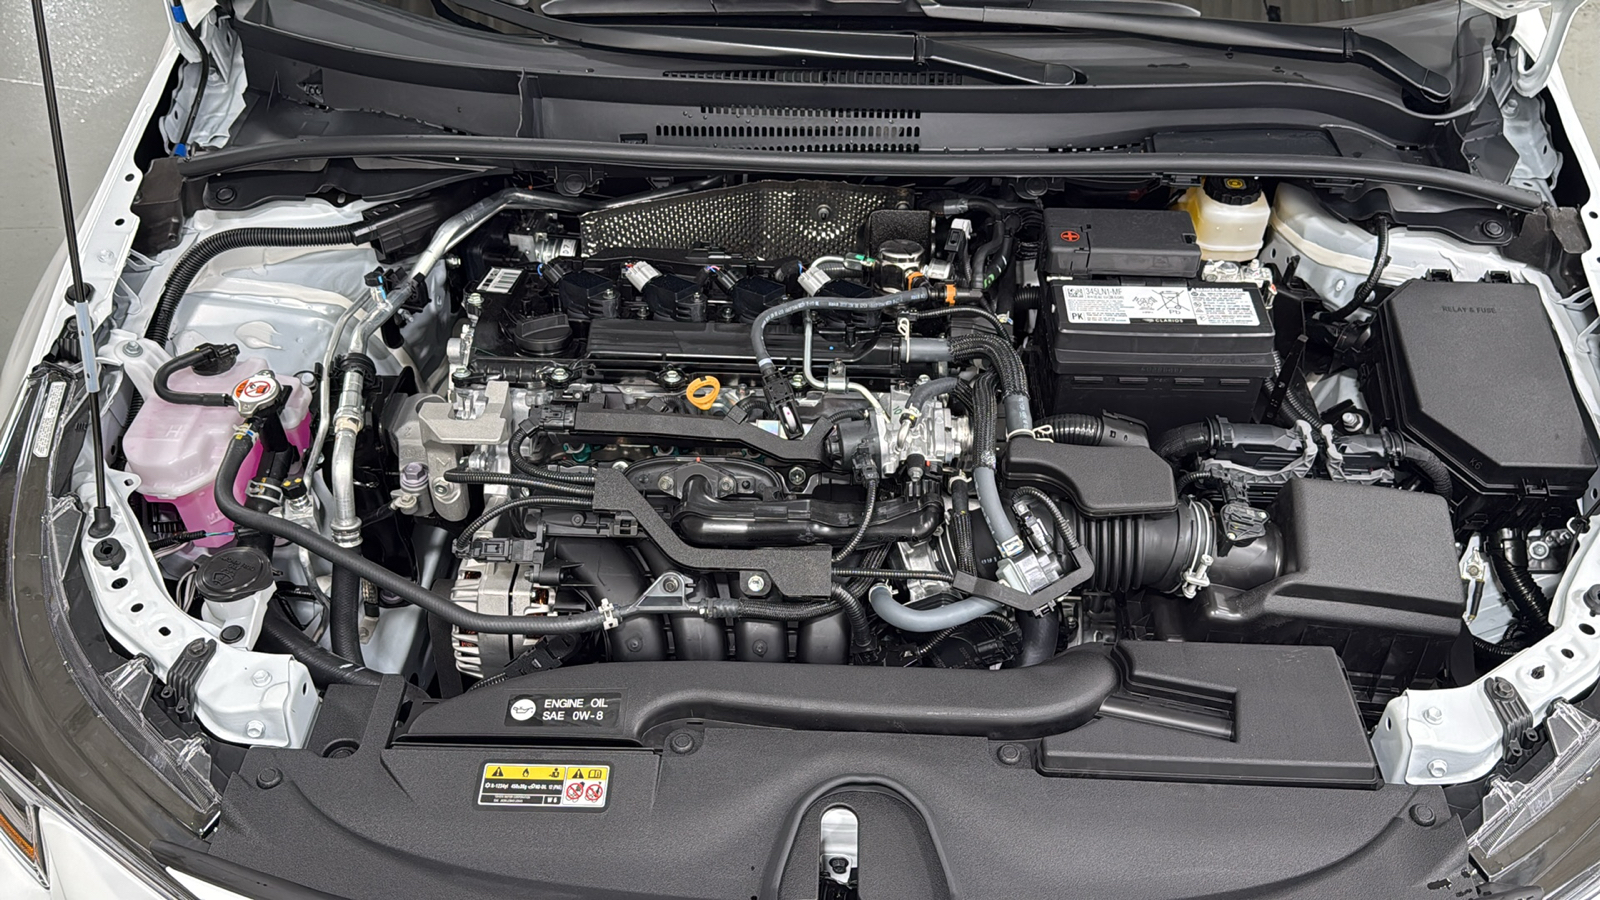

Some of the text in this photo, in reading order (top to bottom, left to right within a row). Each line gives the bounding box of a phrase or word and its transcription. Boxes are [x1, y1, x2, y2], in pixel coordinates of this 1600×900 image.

[1441, 305, 1467, 313] RELAY
[1071, 312, 1084, 320] PK
[544, 698, 608, 708] ENGINE OIL
[542, 710, 604, 720] SAE 0W-8
